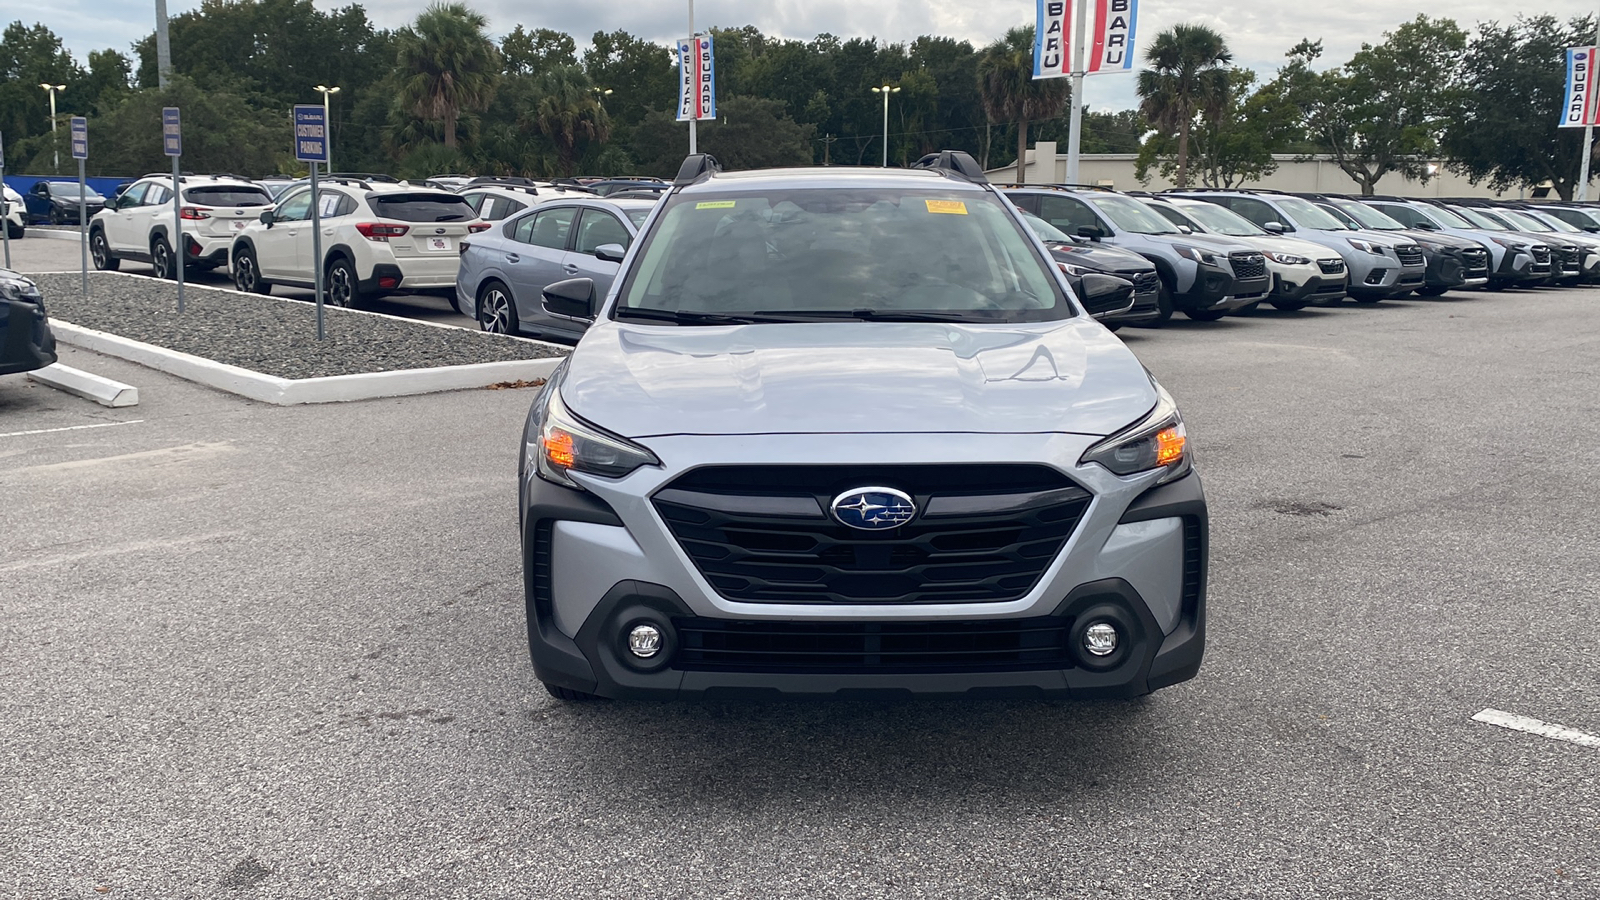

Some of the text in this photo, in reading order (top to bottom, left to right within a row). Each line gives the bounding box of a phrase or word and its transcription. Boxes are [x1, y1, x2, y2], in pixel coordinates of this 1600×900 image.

[702, 52, 711, 114] SUBARU
[1569, 63, 1585, 122] SUBARU
[297, 124, 324, 137] CUSTOMER
[300, 141, 323, 154] PARKING
